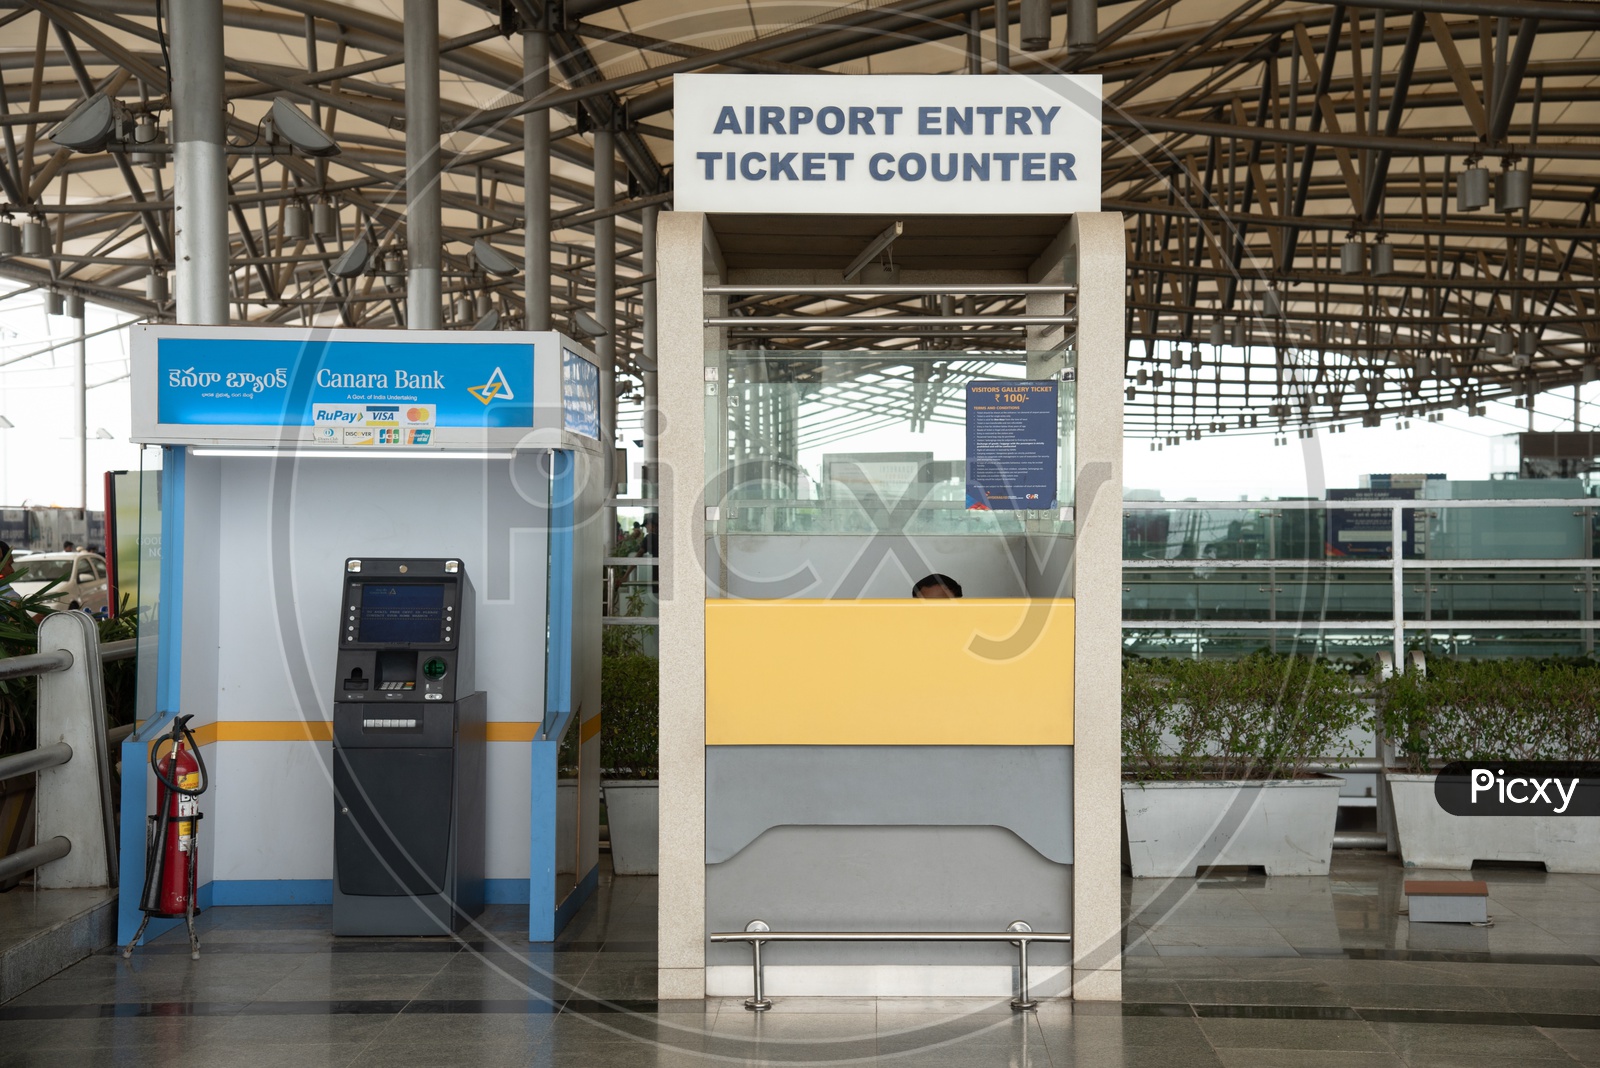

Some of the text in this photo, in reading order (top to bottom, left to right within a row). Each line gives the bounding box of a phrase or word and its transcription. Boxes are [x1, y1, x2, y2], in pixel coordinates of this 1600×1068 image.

[713, 105, 1061, 136] AIRPORT ENTRY
[696, 152, 1077, 182] TICKET COUNTER
[316, 368, 446, 389] Canara Bank
[1003, 393, 1030, 403] 100/-
[316, 410, 358, 424] RuPay
[372, 412, 395, 421] VISA
